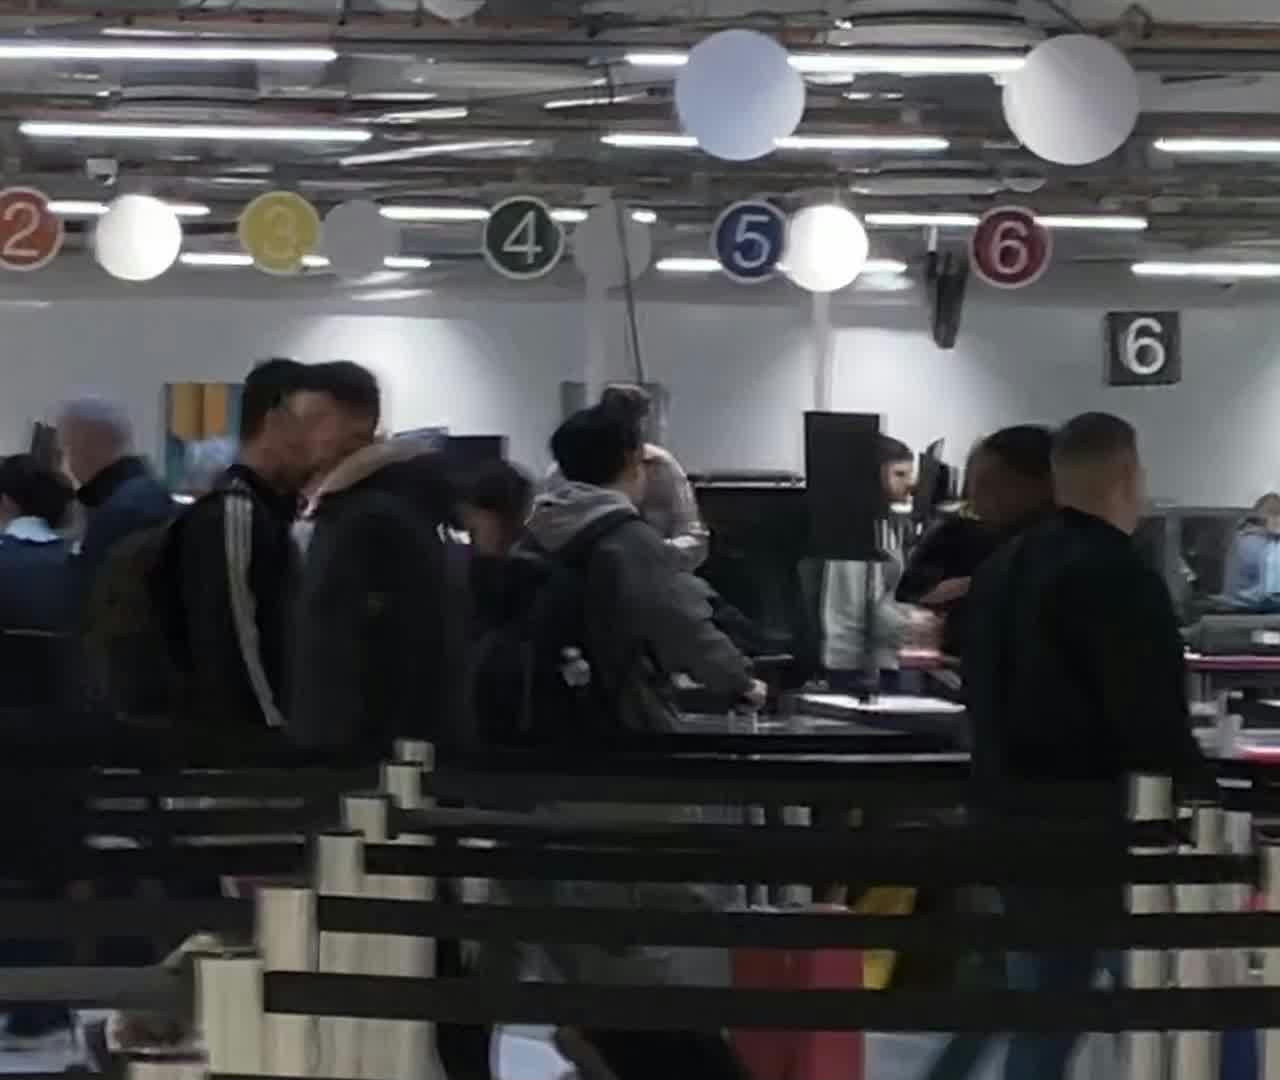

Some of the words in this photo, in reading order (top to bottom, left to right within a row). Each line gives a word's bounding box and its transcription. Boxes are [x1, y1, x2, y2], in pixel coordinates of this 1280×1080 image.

[3, 201, 40, 257] 2
[264, 204, 297, 260] 3
[503, 210, 543, 264] 4
[733, 213, 770, 269] 5
[993, 220, 1028, 275] 6
[1123, 317, 1166, 375] 6
